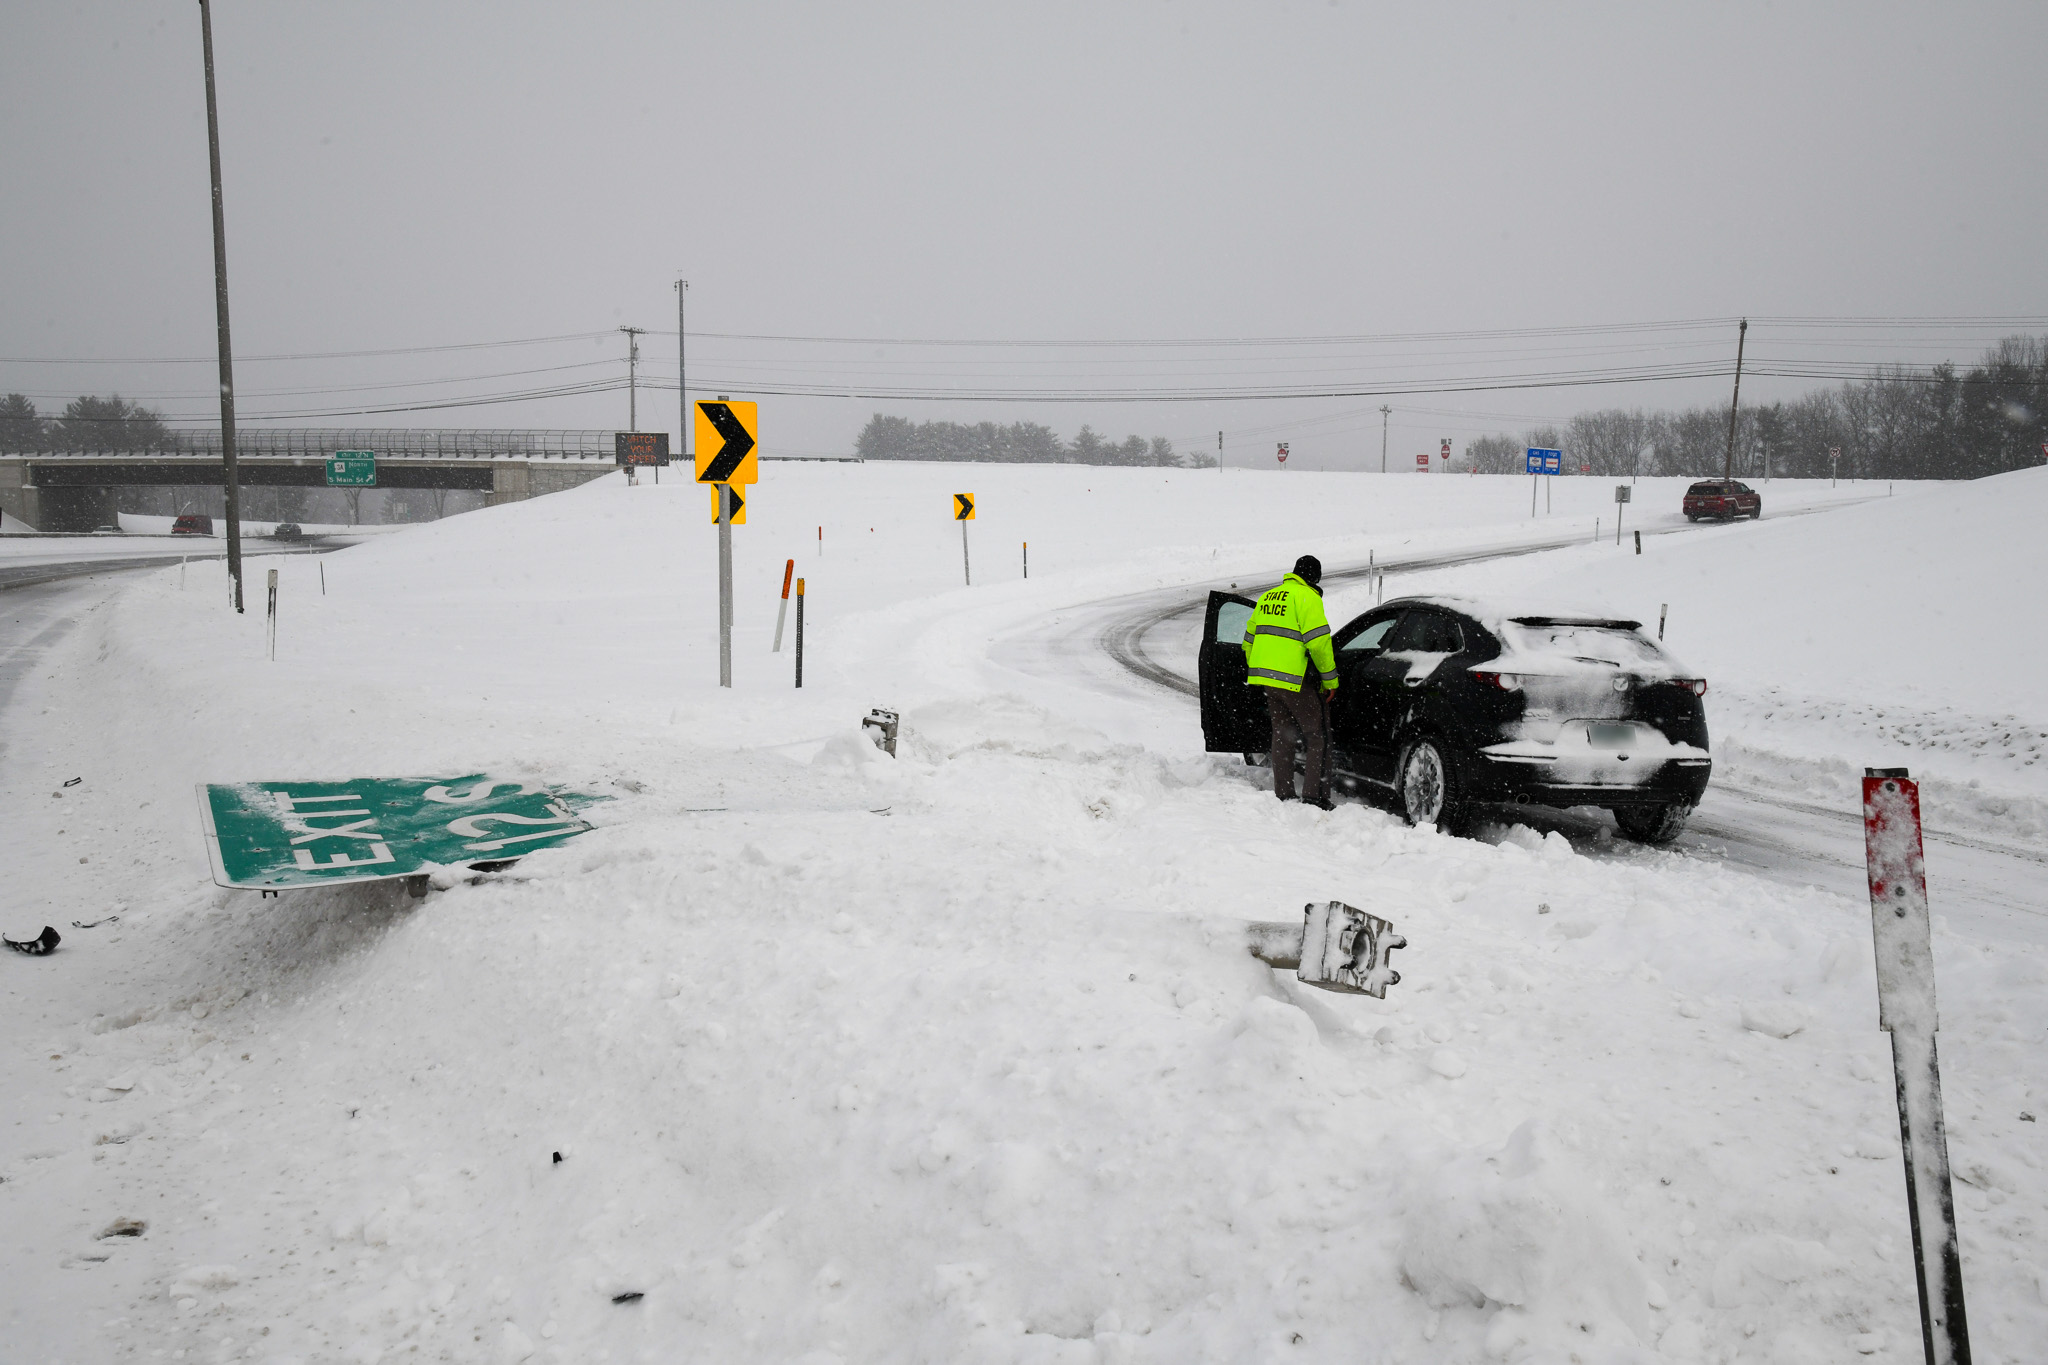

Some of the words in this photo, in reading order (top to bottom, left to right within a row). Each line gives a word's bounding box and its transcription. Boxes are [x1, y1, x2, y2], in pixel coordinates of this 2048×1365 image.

[627, 435, 657, 443] WATCH
[630, 445, 654, 453] YOUR
[627, 454, 657, 463] SPEED
[1264, 591, 1289, 601] STATE
[273, 791, 396, 871] EXIT
